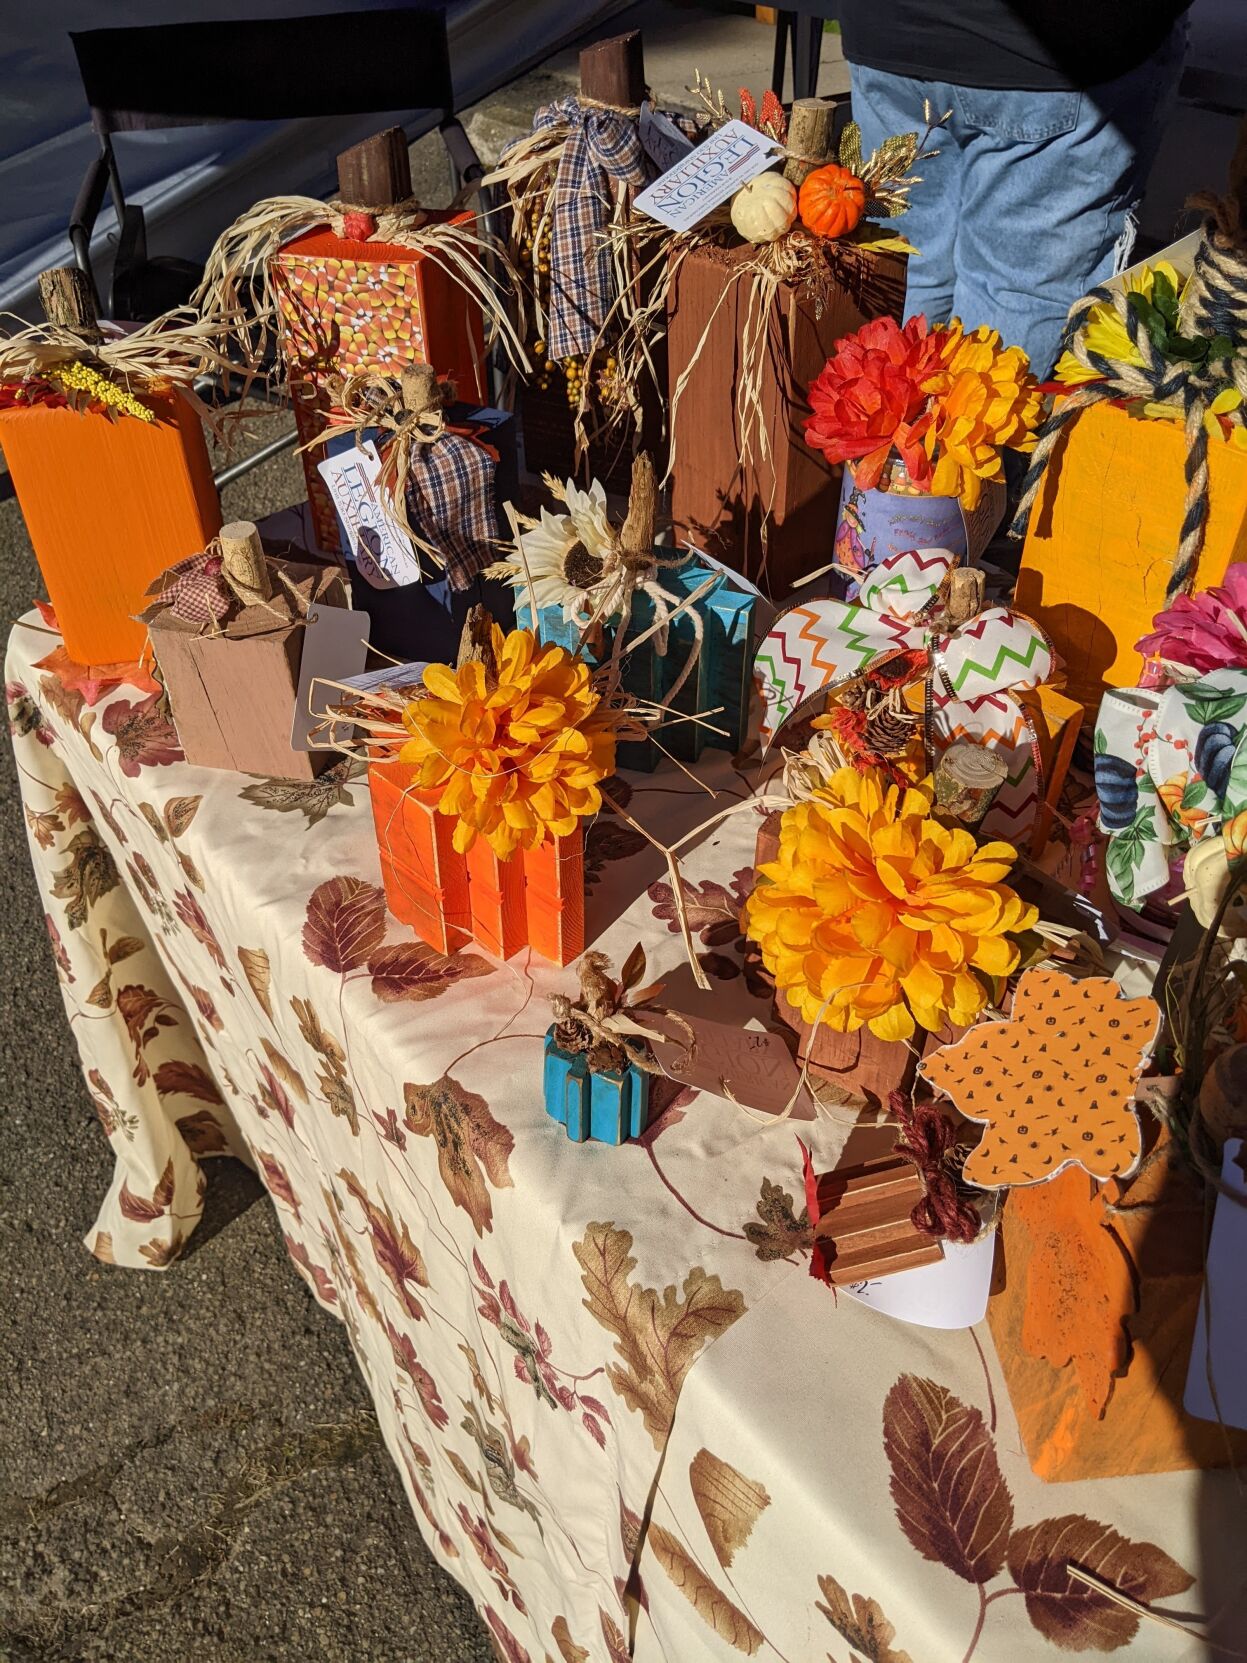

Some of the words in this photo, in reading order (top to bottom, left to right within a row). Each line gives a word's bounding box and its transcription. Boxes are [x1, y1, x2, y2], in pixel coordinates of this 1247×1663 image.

[649, 127, 737, 205] AUXILIARY
[655, 136, 755, 214] LEGION
[668, 168, 728, 219] AMERICAN
[341, 462, 393, 577] LEGION
[369, 502, 401, 575] AMERICAN
